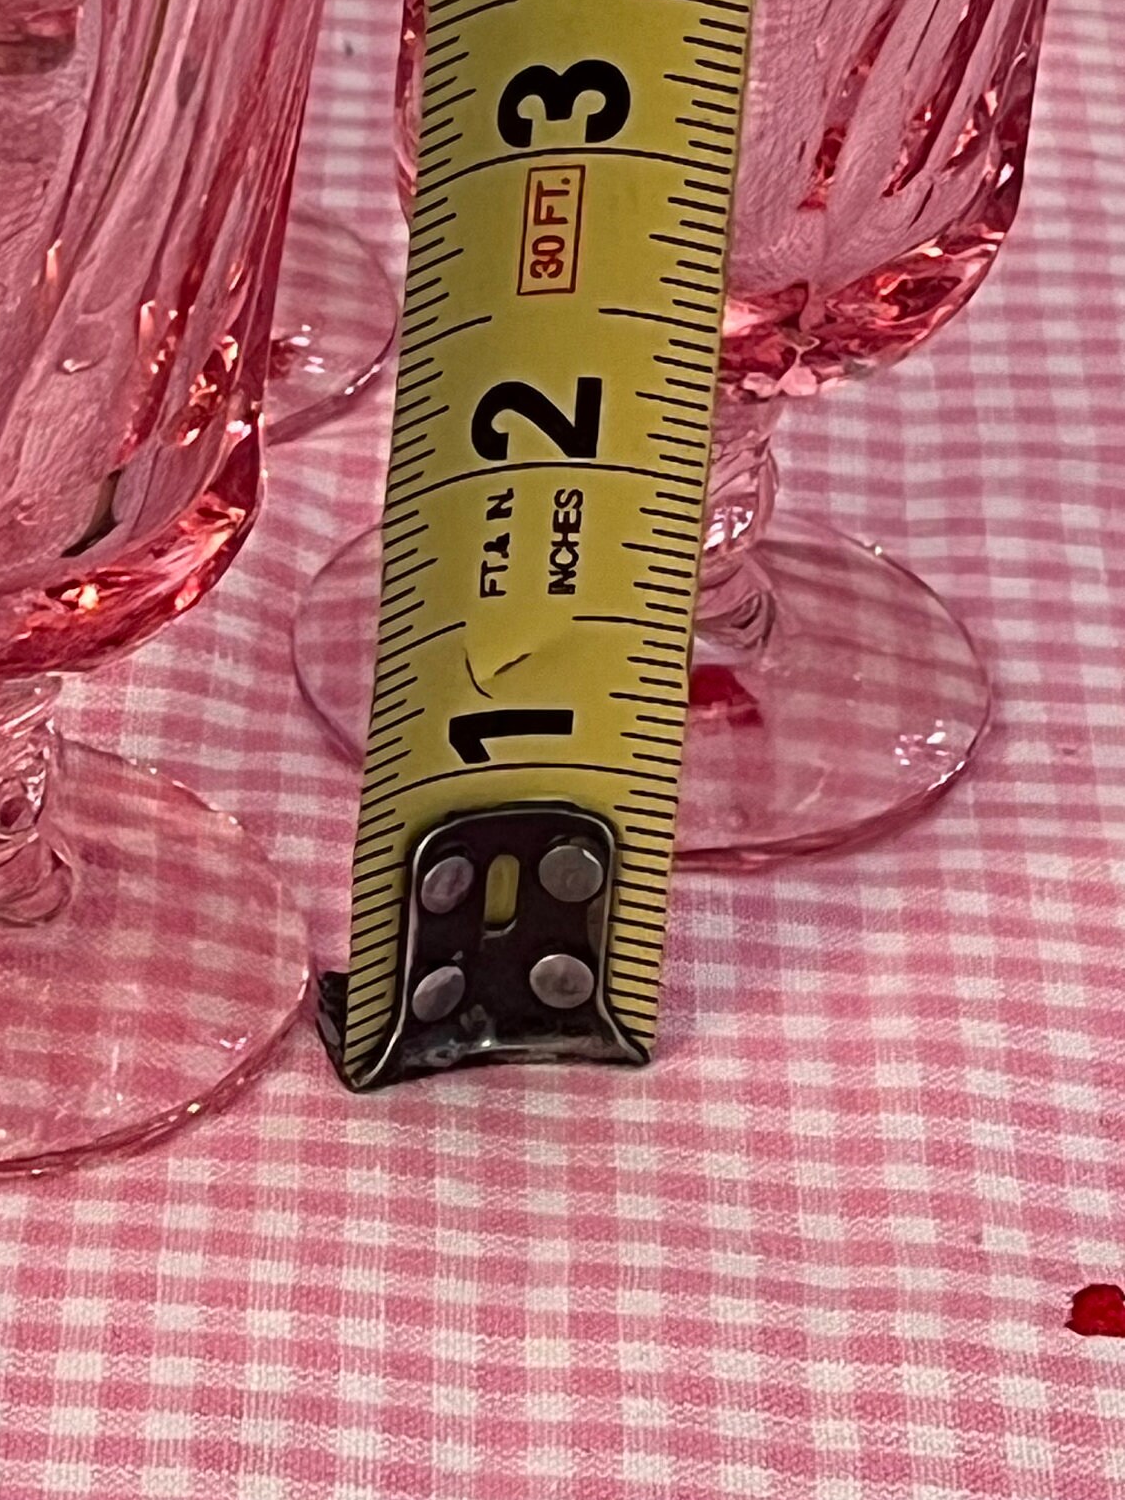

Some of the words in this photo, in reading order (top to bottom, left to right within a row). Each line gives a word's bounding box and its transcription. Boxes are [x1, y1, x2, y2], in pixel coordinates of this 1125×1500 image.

[497, 59, 631, 148] 3
[533, 177, 572, 226] FT.
[530, 235, 565, 279] 30
[471, 377, 603, 461] 2
[548, 488, 584, 595] INCHES
[449, 709, 574, 764] 1
